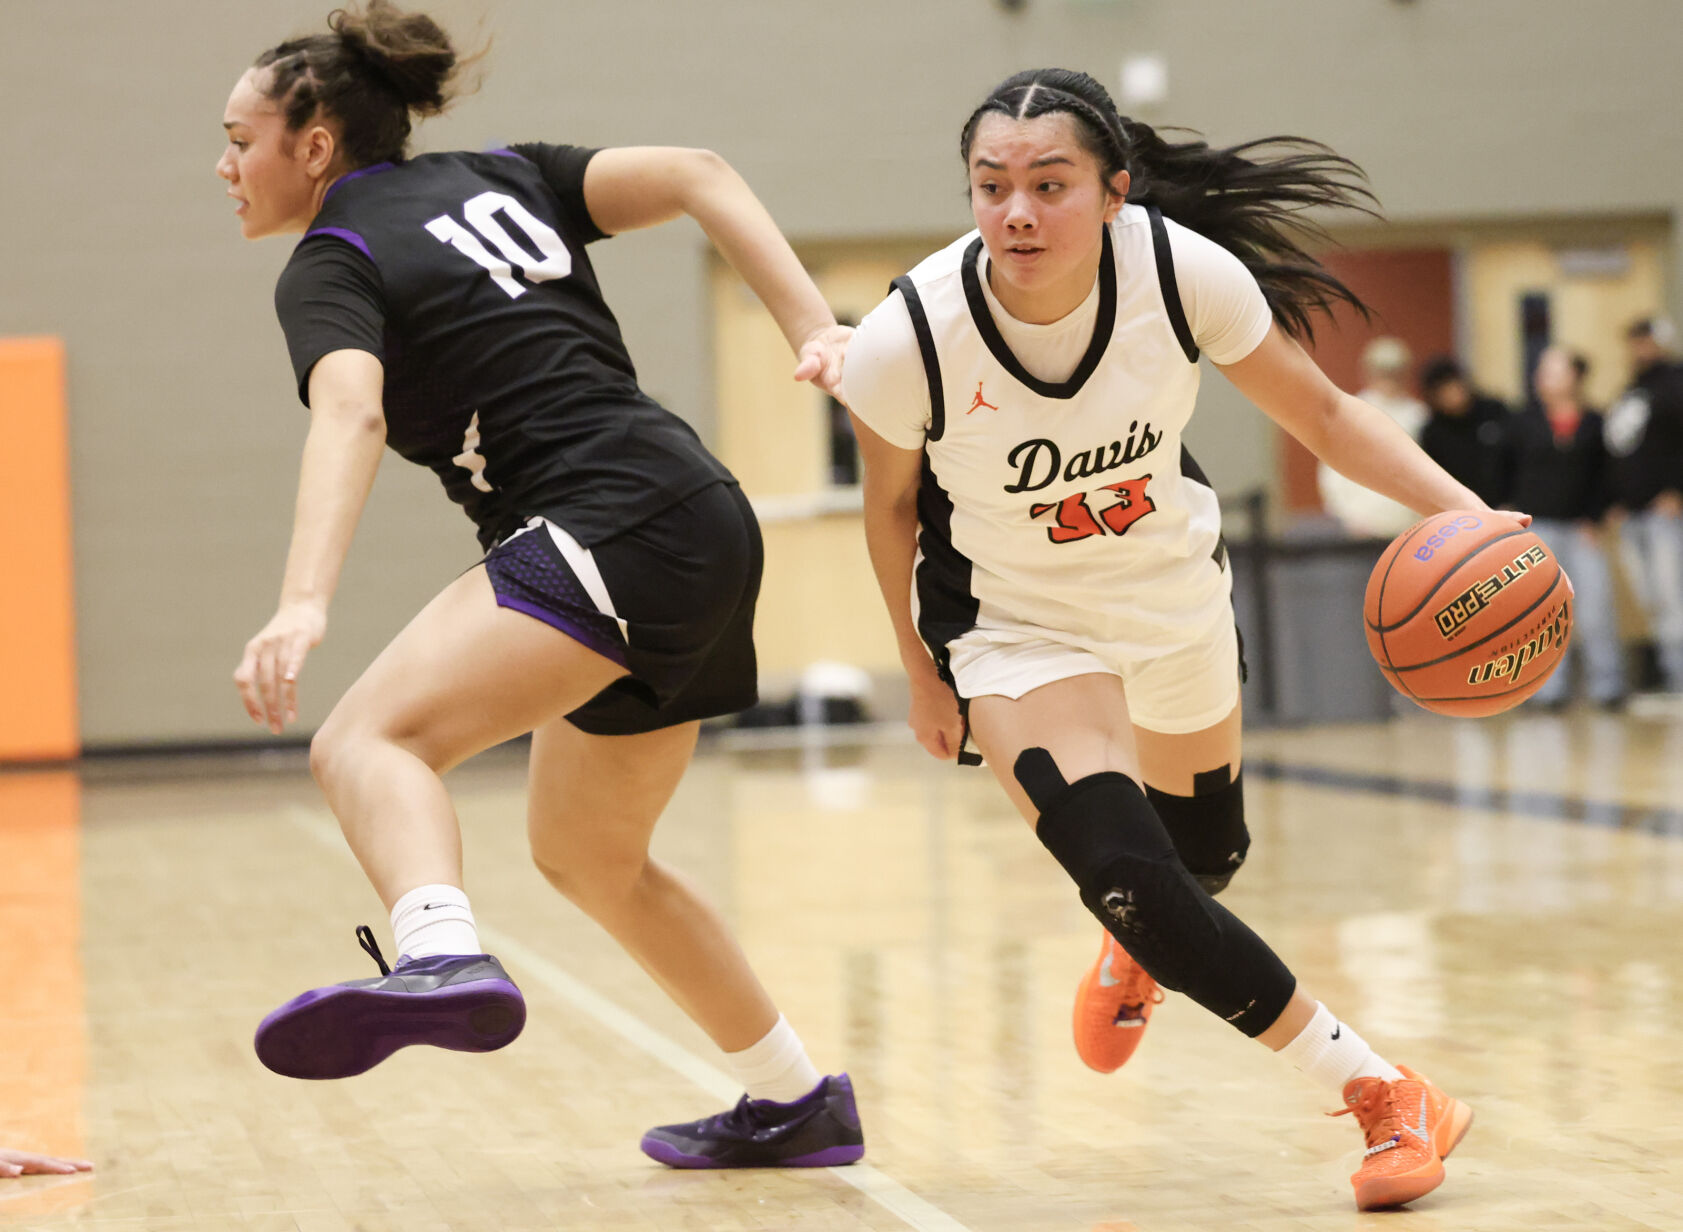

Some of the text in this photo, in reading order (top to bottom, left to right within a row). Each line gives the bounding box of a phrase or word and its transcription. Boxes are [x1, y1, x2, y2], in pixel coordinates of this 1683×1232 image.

[423, 191, 572, 300] 10
[1003, 420, 1163, 494] Davis
[1414, 515, 1483, 562] Gesa
[1436, 544, 1547, 636] ELITE PRO
[1467, 599, 1569, 685] Baden
